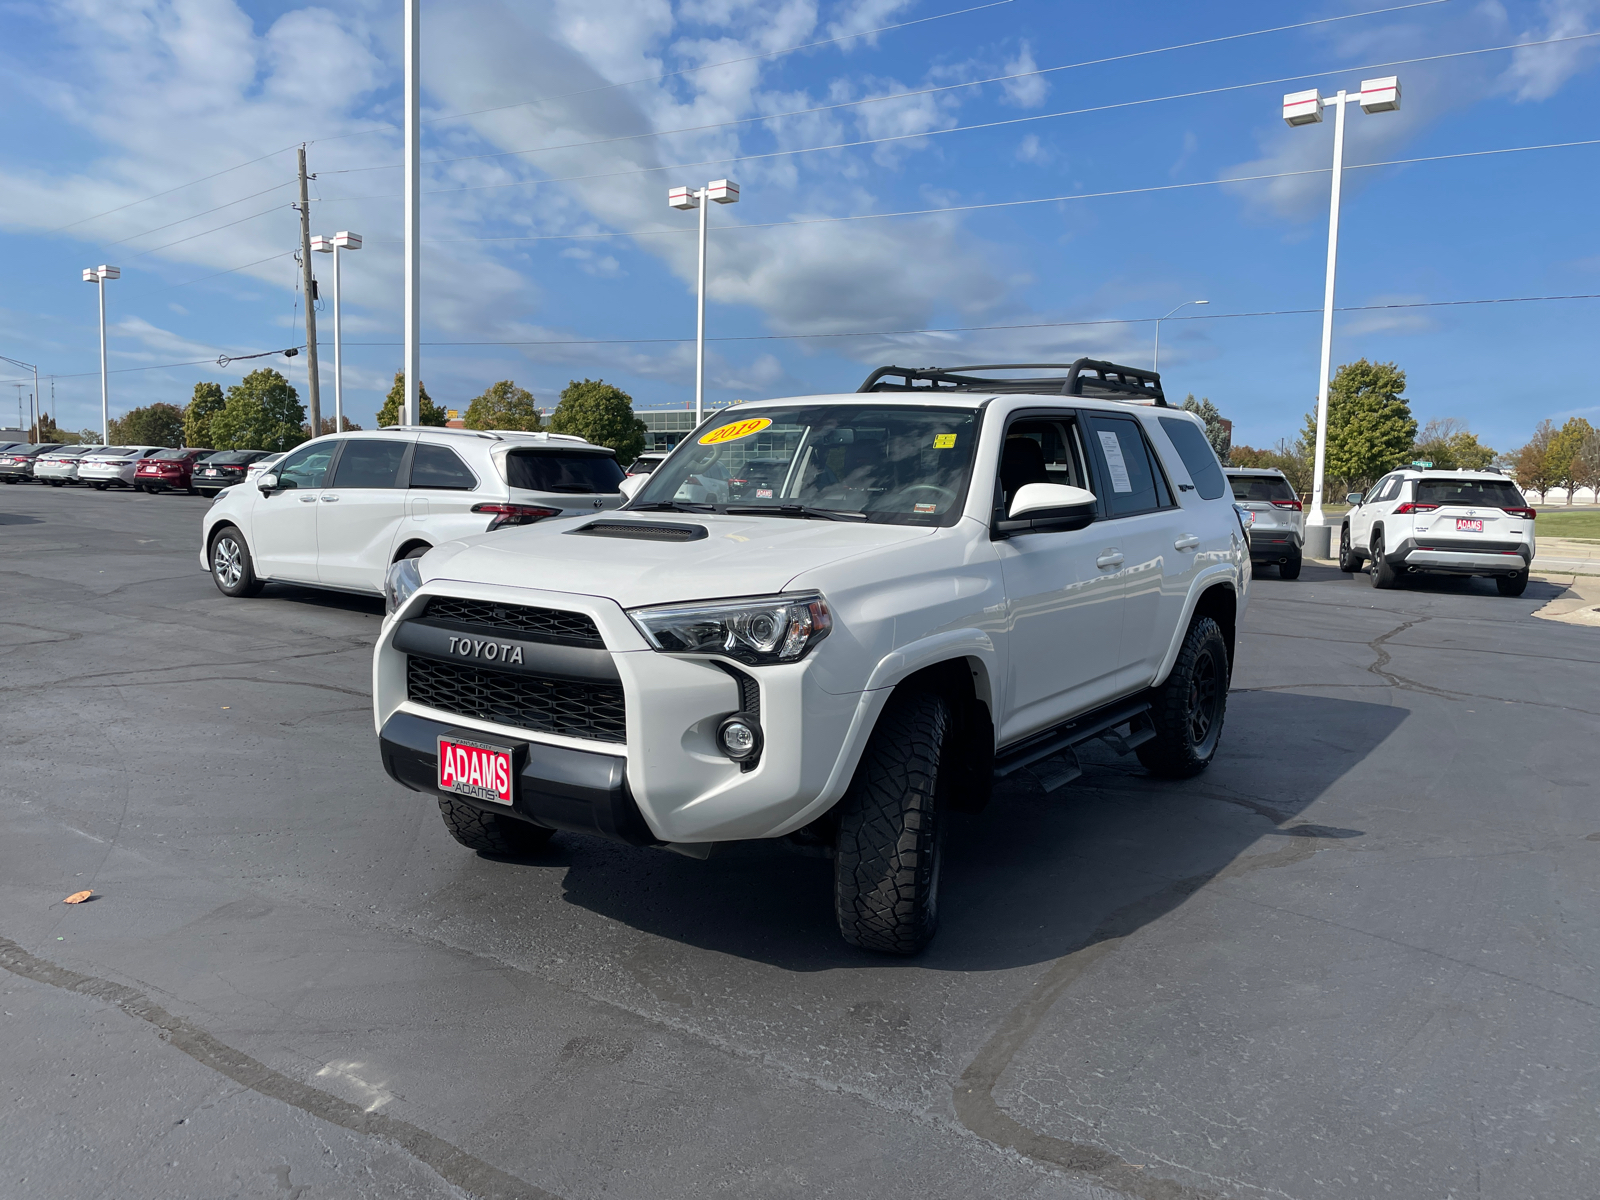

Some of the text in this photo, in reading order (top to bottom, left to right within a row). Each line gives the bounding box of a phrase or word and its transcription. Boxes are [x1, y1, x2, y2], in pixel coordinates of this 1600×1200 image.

[708, 420, 761, 442] 2019
[1457, 519, 1481, 530] ADAMS
[449, 636, 524, 664] TOYOTA
[456, 739, 479, 748] KANSAS
[443, 746, 508, 794] ADAMS
[454, 782, 496, 800] ADAMS
